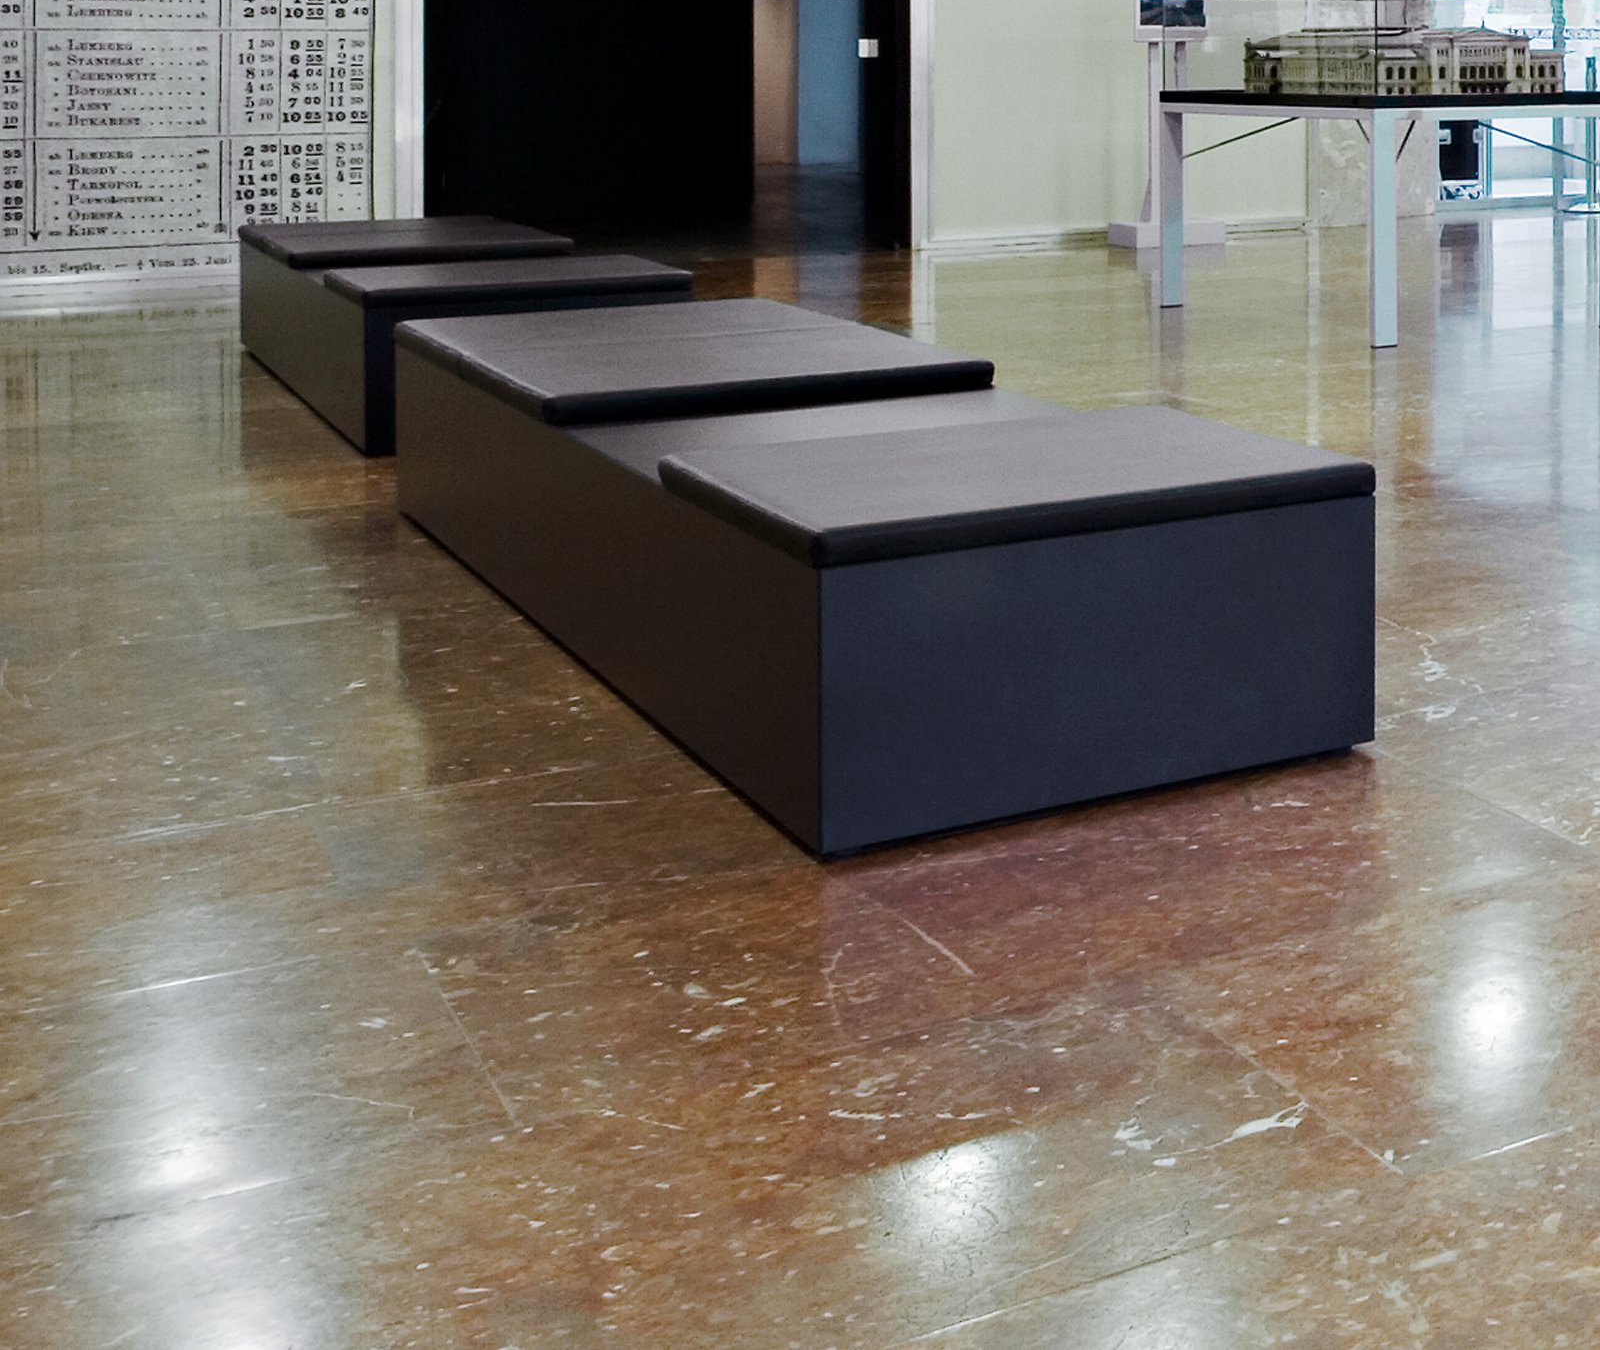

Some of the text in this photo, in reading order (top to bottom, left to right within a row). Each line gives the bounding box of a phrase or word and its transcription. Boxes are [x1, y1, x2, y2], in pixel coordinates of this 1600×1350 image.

[243, 7, 254, 18] 2
[285, 7, 304, 18] 10
[335, 8, 345, 19] 8
[248, 38, 254, 50] 1
[290, 54, 301, 65] 6
[288, 68, 300, 79] 4
[330, 66, 346, 79] 10
[288, 97, 298, 108] 7
[283, 111, 302, 123] 10
[327, 111, 346, 123] 10
[243, 146, 254, 157] 2
[283, 144, 302, 156] 10
[238, 174, 255, 185] 11
[236, 189, 255, 200] 10
[244, 203, 255, 215] 9
